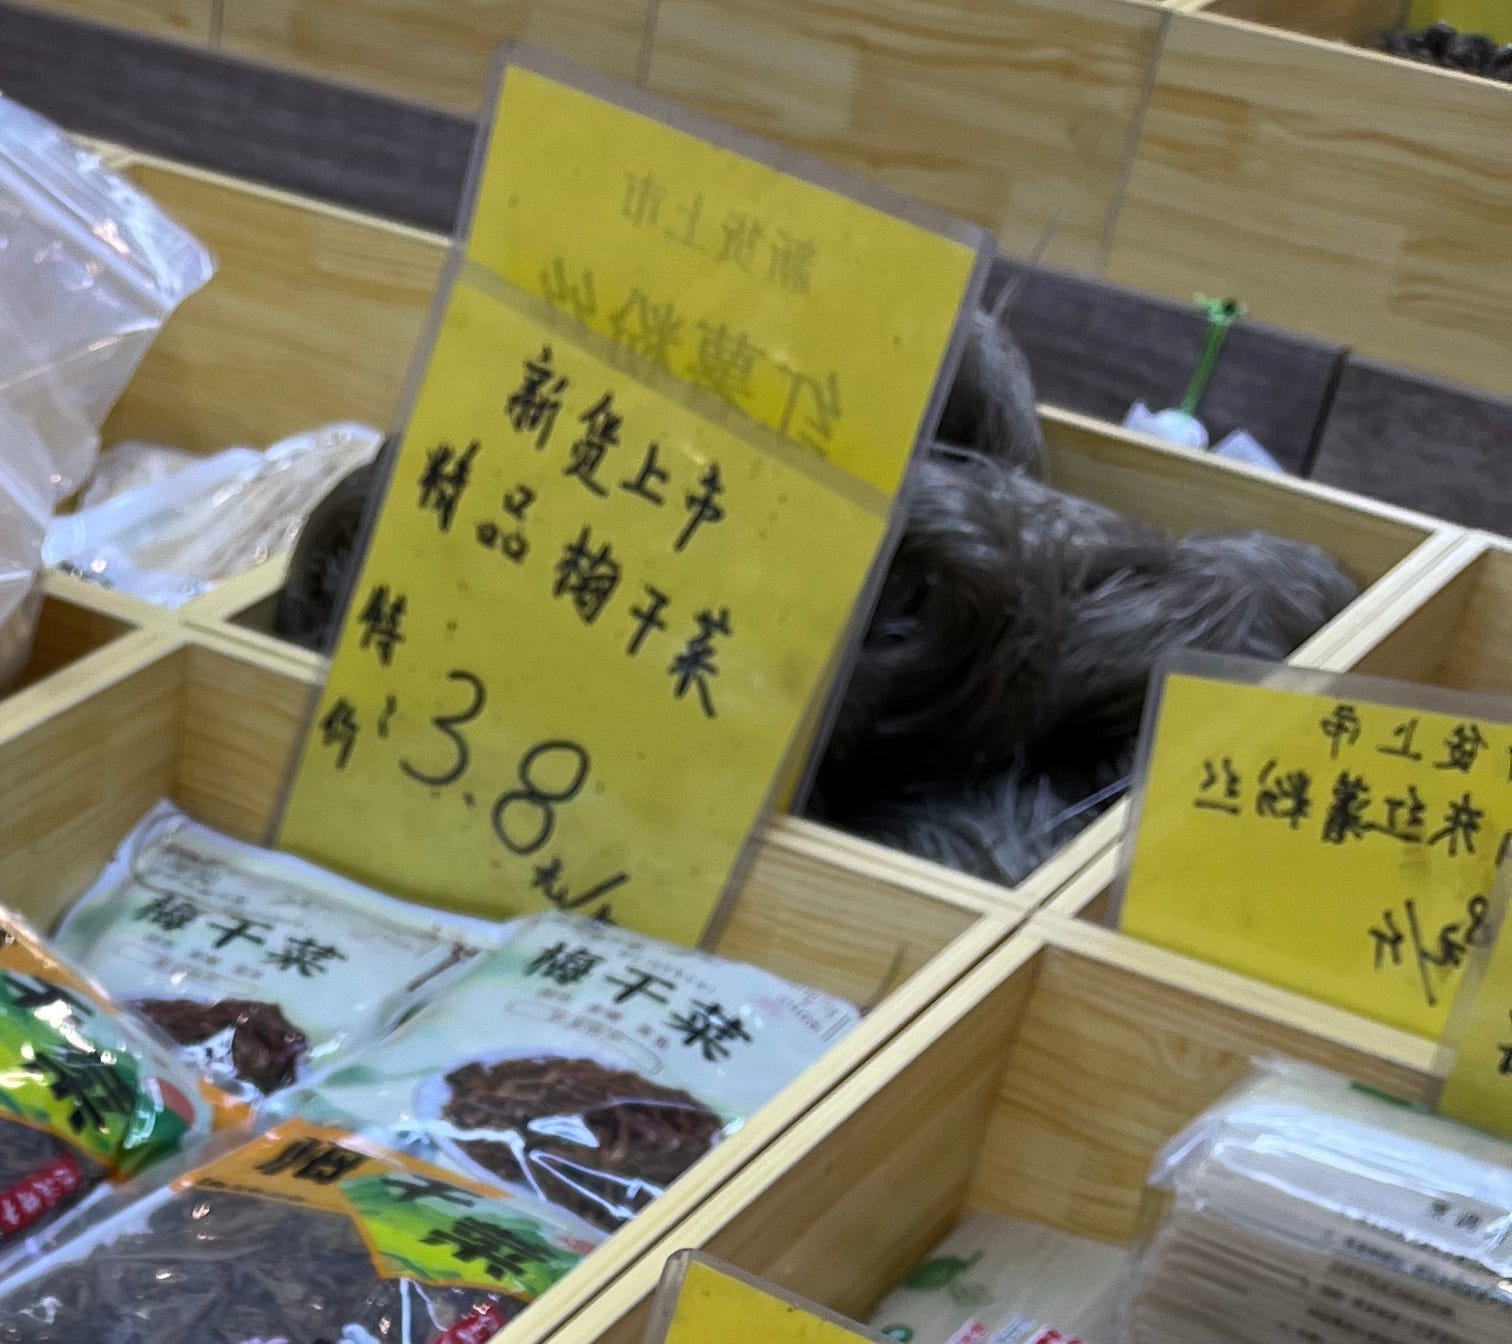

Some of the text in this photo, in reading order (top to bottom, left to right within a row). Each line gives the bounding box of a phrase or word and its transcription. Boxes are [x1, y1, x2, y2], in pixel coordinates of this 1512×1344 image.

[505, 345, 727, 552] 新货上市
[399, 670, 591, 856] 3.8
